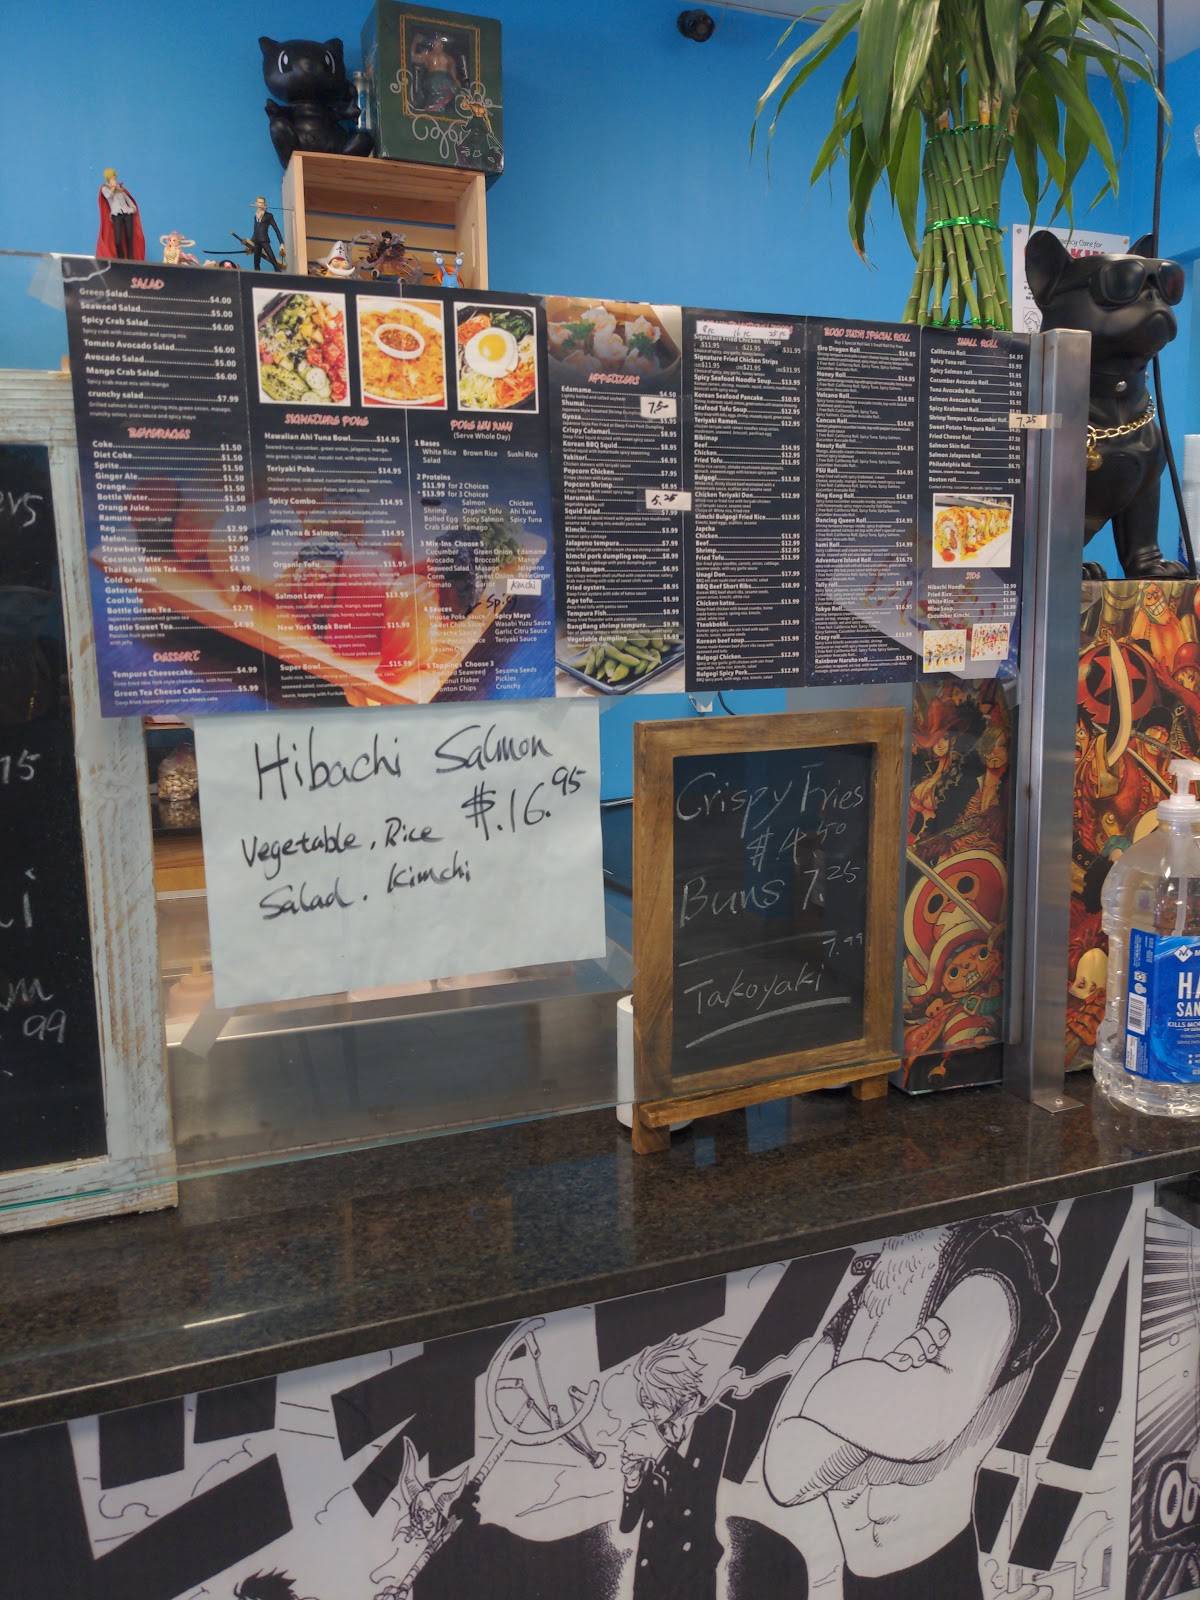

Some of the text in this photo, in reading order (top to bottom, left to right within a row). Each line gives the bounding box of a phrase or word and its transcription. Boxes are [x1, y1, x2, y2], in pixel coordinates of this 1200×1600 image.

[130, 277, 164, 289] SALAD
[80, 288, 104, 296] Green
[106, 289, 128, 298] Salad
[81, 303, 233, 318] Seaweed Salad $5.00
[82, 316, 104, 325] Spicy
[84, 339, 115, 347] Tomato
[117, 341, 151, 350] Avocado
[85, 353, 120, 362] Avocado
[86, 368, 115, 377] Mango
[88, 391, 120, 399] crunchy
[267, 465, 296, 474] Teriyaki
[269, 498, 288, 506] Spicy
[108, 624, 133, 632] Bottle
[113, 671, 147, 679] Tempura
[114, 689, 138, 698] Green
[183, 687, 201, 695] Cake
[254, 724, 553, 800] Hibachi Salmon
[676, 762, 864, 838] Crispy Fries
[385, 817, 443, 848] Rice
[387, 851, 471, 894] Kimchi
[680, 860, 863, 928] Buns 7.25
[684, 964, 824, 1015] Takoyaki
[1177, 972, 1200, 999] H
